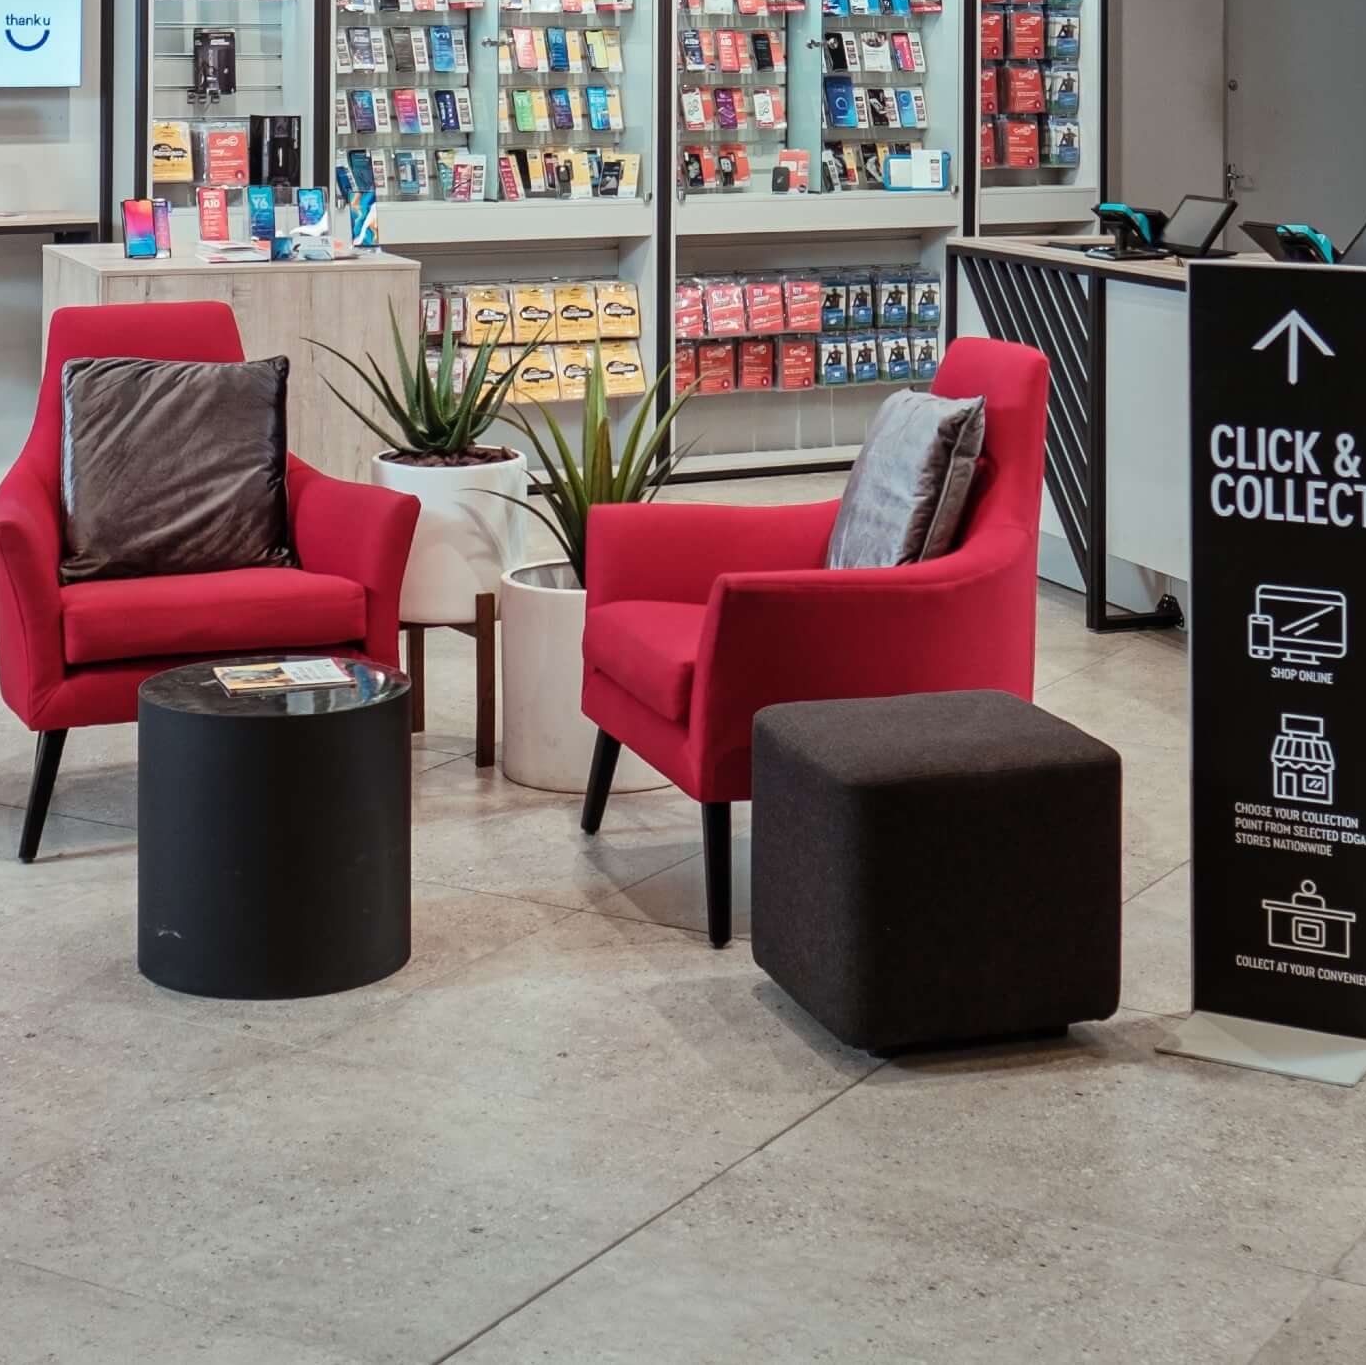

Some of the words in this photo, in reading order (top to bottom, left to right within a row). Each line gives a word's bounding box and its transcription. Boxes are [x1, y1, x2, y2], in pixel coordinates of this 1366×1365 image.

[5, 13, 42, 26] thank
[43, 16, 51, 27] u
[203, 197, 220, 209] A10
[251, 197, 269, 210] Y6
[1210, 424, 1321, 475] CLICK
[1334, 433, 1362, 478] &
[1271, 667, 1297, 681] SHOP
[1299, 670, 1334, 685] ONLINE
[1235, 802, 1272, 817] CHOOSE
[1274, 807, 1300, 821] YOUR
[1301, 811, 1359, 829] COLLECTION
[1235, 817, 1263, 831] POINT
[1264, 821, 1291, 835] FROM
[1293, 825, 1339, 842] SELECTED
[1235, 832, 1271, 848] STORES
[1272, 839, 1333, 856] NATIONWIDE
[1236, 954, 1275, 971] COLLECT
[1276, 961, 1287, 973] AT
[1289, 964, 1316, 978] YOUR
